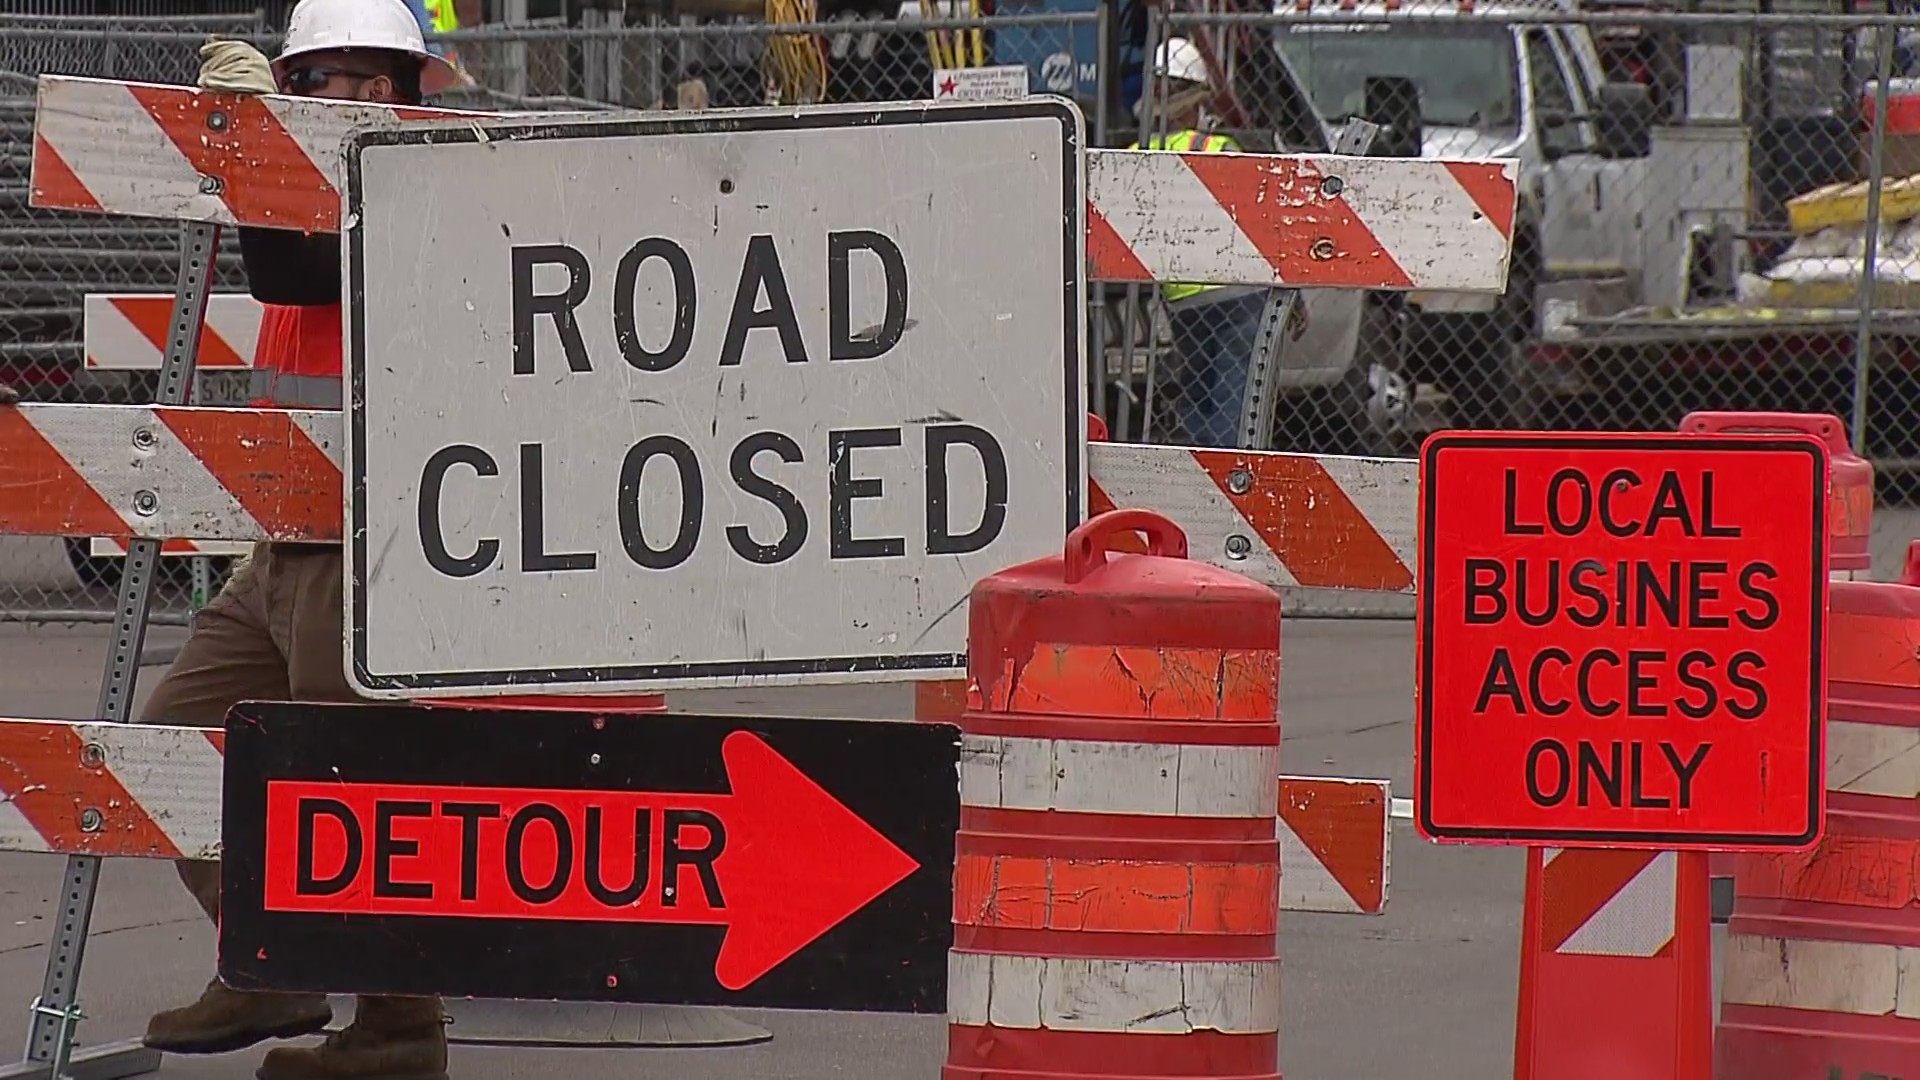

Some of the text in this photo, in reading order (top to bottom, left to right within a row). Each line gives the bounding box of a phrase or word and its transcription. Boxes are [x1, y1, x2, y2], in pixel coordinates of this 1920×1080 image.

[511, 230, 910, 376] ROAD
[417, 424, 1009, 578] CLOSED
[1504, 468, 1742, 537] LOCAL
[1464, 558, 1780, 631] BUSINES
[1474, 646, 1768, 719] ACCESS
[1525, 738, 1712, 809] ONLY
[296, 797, 727, 910] DETOUR
